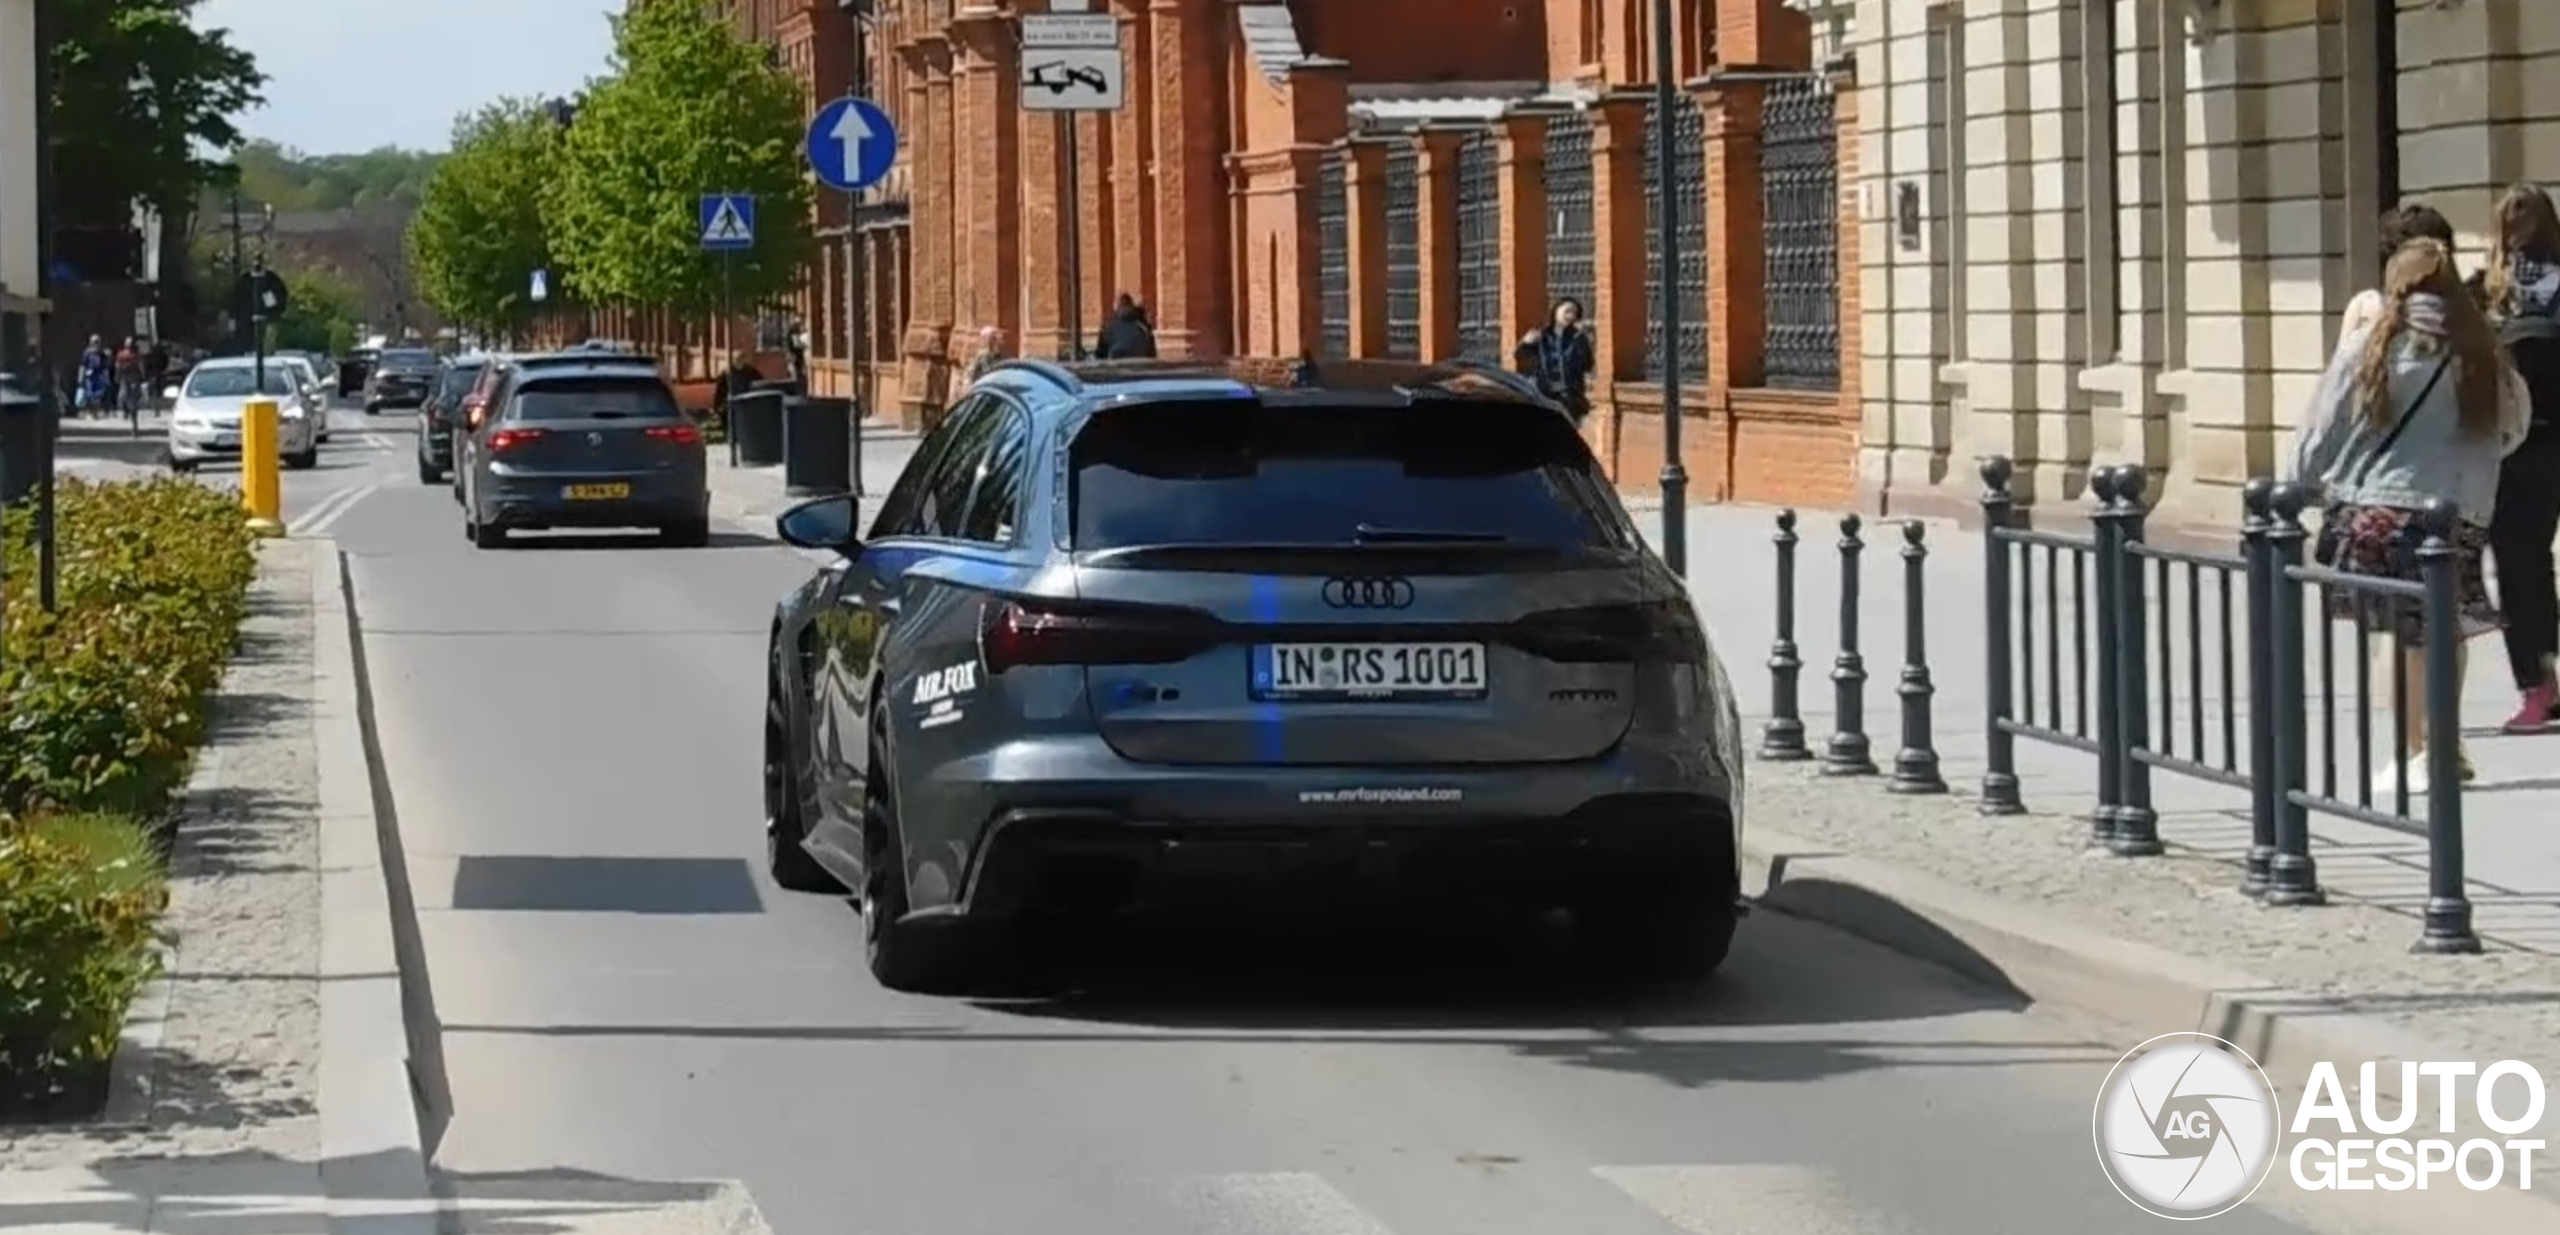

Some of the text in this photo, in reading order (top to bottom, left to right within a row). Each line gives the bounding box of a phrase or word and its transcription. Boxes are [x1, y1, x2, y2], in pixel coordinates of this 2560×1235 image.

[1277, 648, 1479, 685] IN RS 1001
[1299, 786, 1463, 803] www.mrfoxpoland.com
